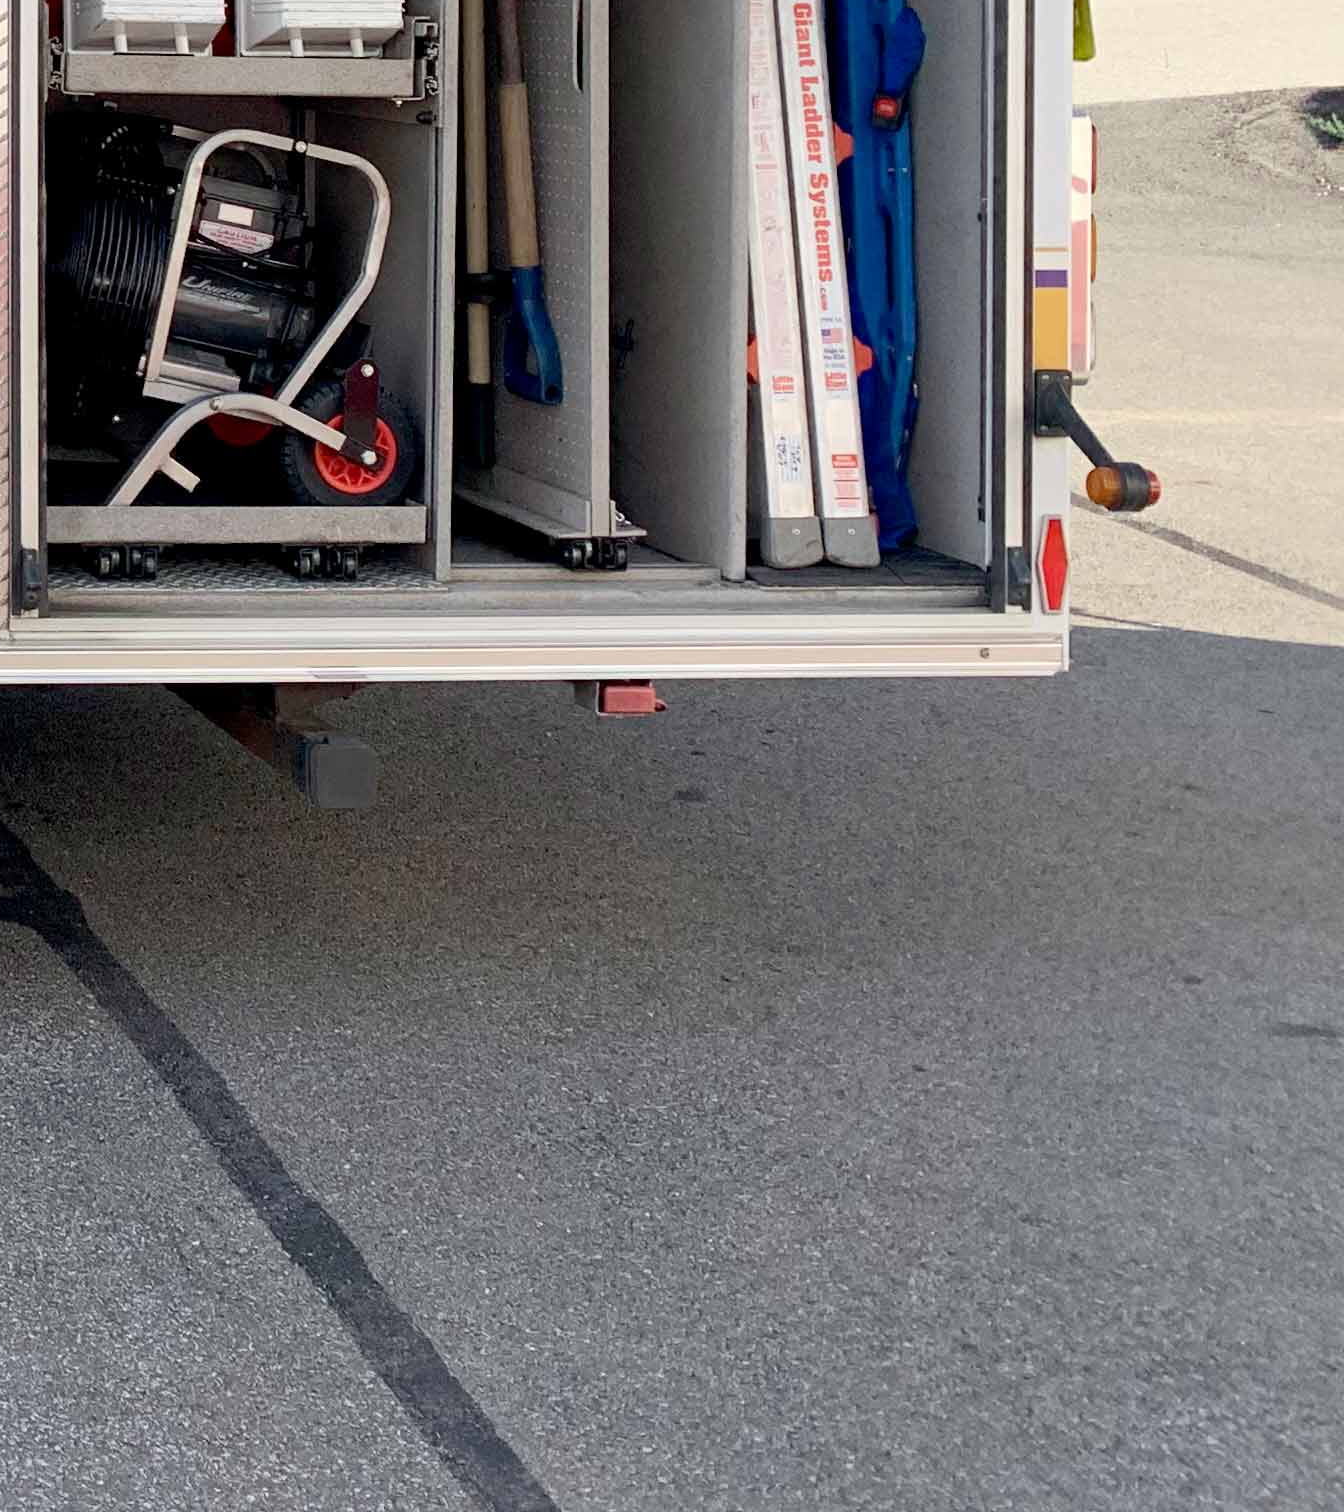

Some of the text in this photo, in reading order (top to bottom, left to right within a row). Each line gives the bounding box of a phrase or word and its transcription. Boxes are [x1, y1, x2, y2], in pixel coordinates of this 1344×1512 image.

[792, 3, 815, 67] Giant
[800, 75, 825, 164] Ladder
[808, 172, 833, 282] Systems
